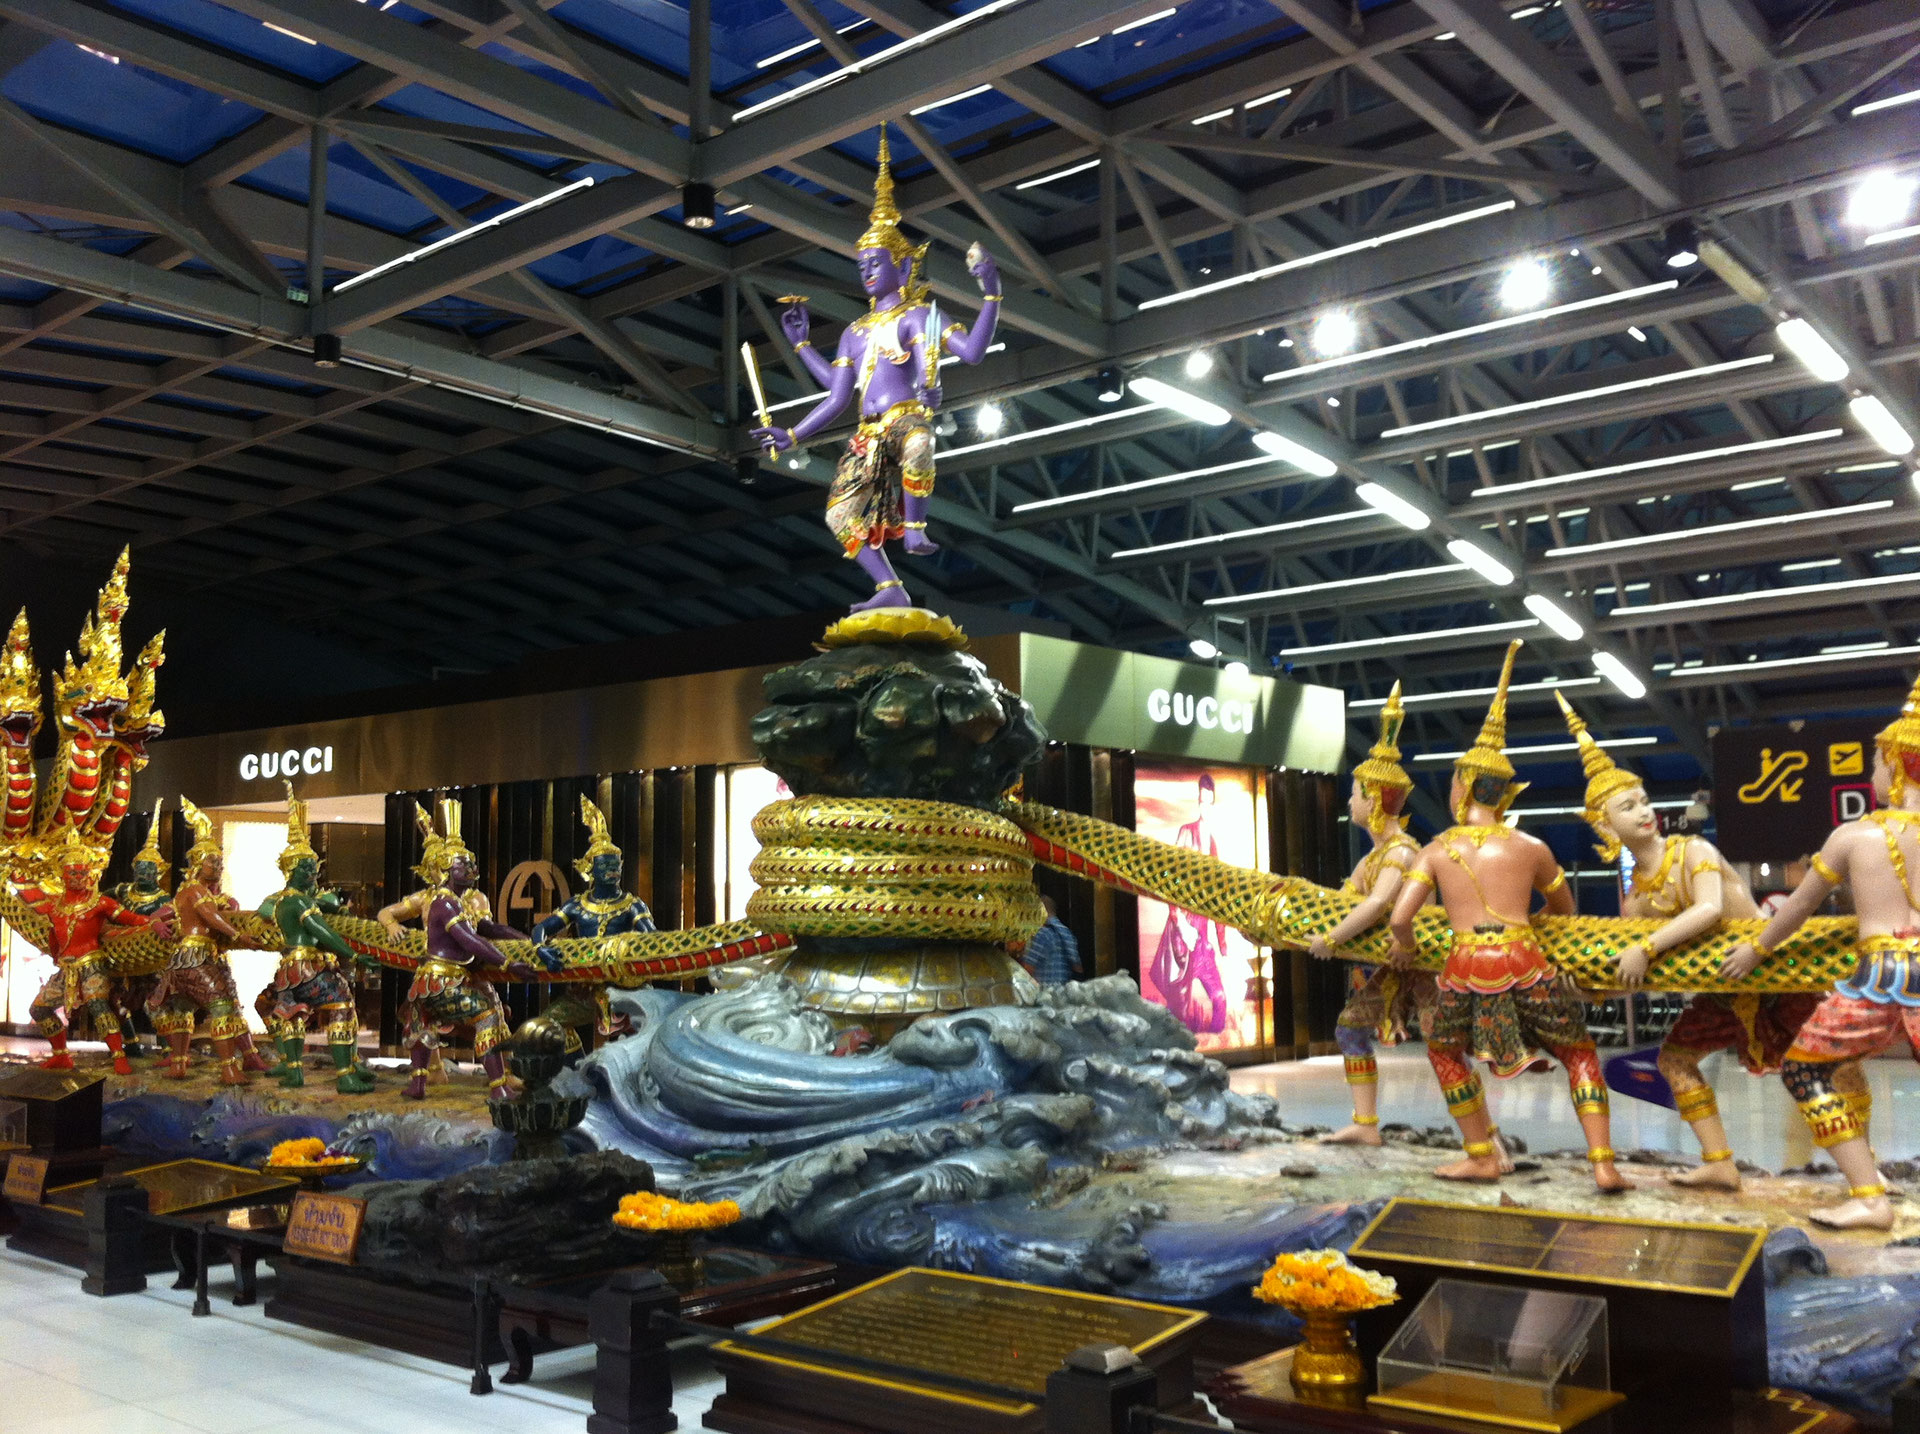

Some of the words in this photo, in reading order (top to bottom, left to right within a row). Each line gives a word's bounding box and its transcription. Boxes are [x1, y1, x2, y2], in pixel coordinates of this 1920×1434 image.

[1147, 688, 1254, 735] GUCCI
[240, 746, 333, 780] GUCCI
[1841, 790, 1866, 820] D
